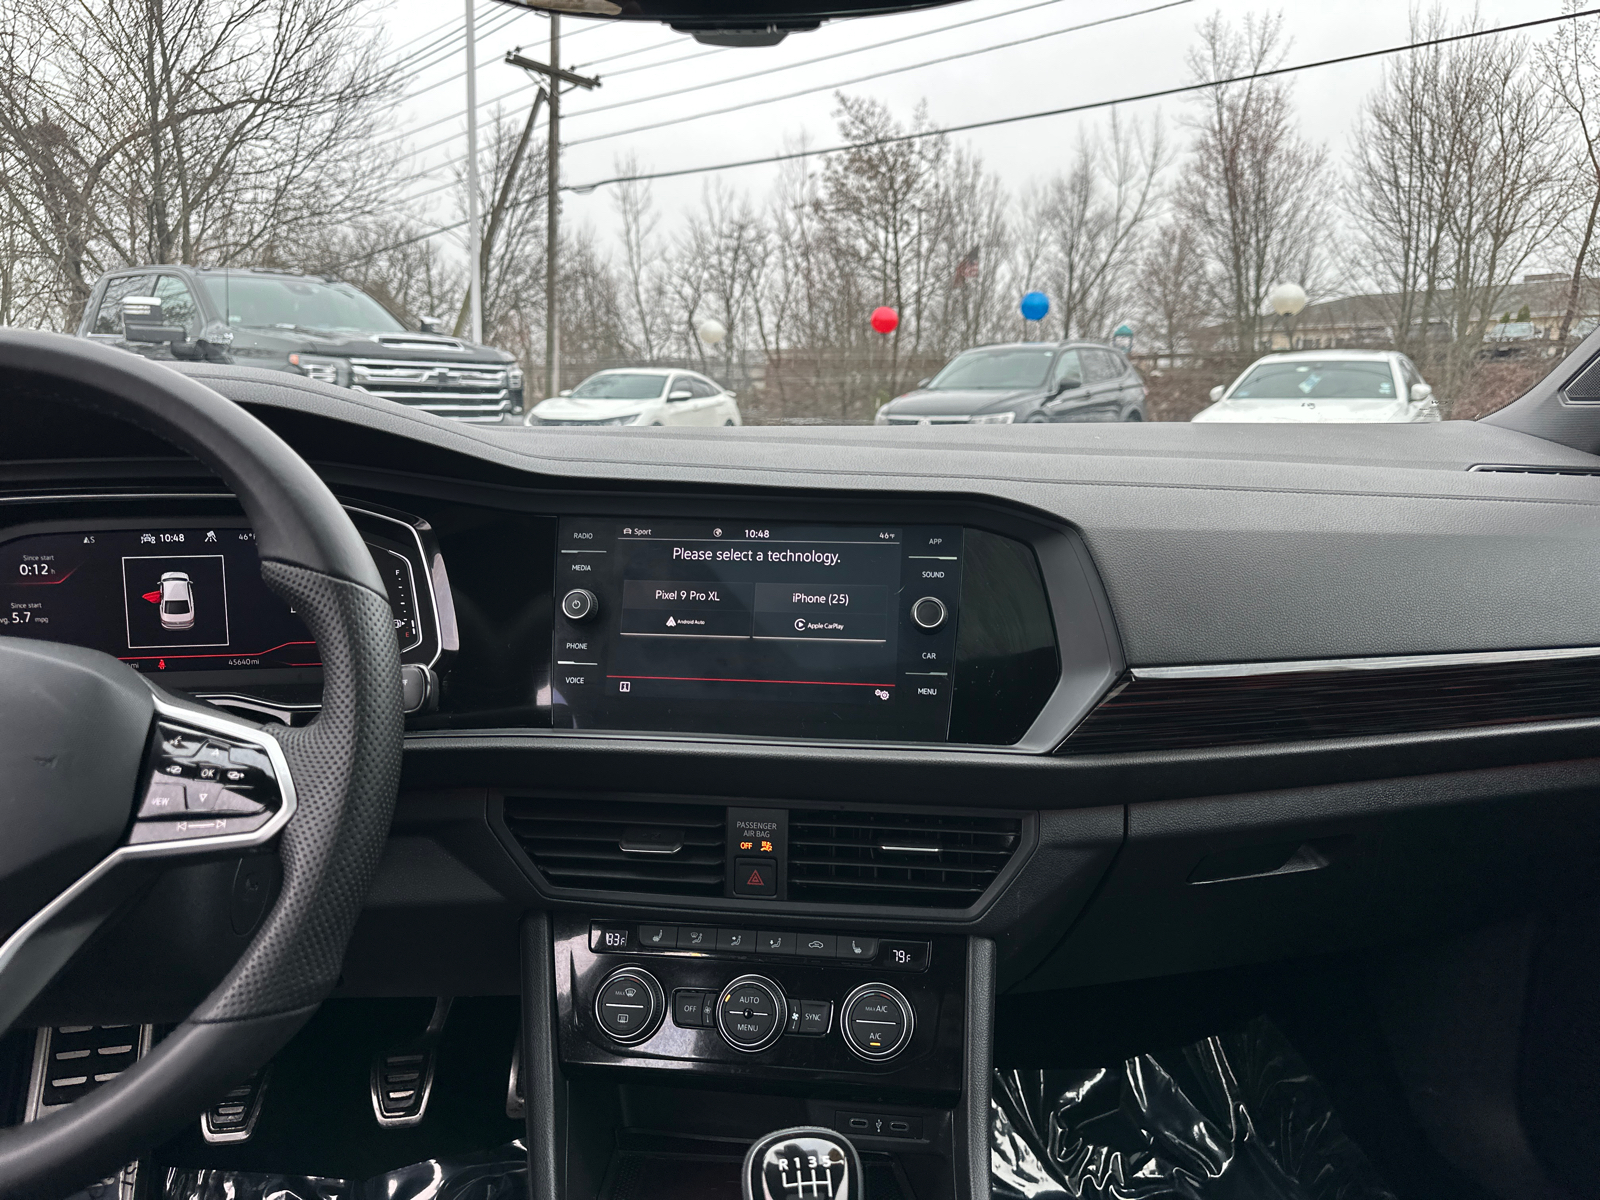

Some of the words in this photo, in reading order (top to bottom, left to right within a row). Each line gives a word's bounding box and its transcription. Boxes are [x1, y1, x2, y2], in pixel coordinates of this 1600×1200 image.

[573, 532, 593, 540] RADIO
[633, 528, 652, 536] Sport
[744, 529, 770, 538] 10:48
[159, 533, 185, 543] 10:48
[929, 538, 943, 546] APP
[672, 547, 713, 560] Please
[716, 548, 753, 561] select
[756, 552, 764, 562] a
[767, 549, 841, 566] technology.
[19, 563, 49, 576] 0:12
[571, 564, 592, 572] MEDIA
[921, 571, 945, 579] SOUND
[655, 589, 678, 601] Pixel
[680, 590, 687, 600] 9
[689, 591, 706, 602] Pro
[707, 591, 721, 602] XL
[792, 592, 826, 604] iPhone
[828, 593, 850, 606] (25)
[12, 611, 32, 624] 5.7
[677, 618, 695, 626] Android
[807, 622, 824, 630] Apple
[824, 622, 845, 631] CarPlay
[566, 642, 588, 650] PHONE
[921, 652, 937, 661] CAR
[565, 676, 585, 685] VOICE
[917, 687, 938, 696] MENU
[201, 768, 215, 778] OK
[151, 797, 170, 806] VIEW
[736, 821, 777, 830] PASSENGER
[756, 830, 770, 838] BAG
[740, 841, 753, 850] OFF
[739, 996, 760, 1004] AUTO
[684, 1004, 697, 1013] OFF
[876, 1004, 888, 1013] A/C
[805, 1013, 821, 1022] SYNC
[737, 1024, 759, 1032] MENU
[869, 1032, 882, 1041] A/C
[779, 1158, 789, 1171] R
[793, 1157, 801, 1169] 1
[807, 1156, 818, 1168] 3
[822, 1156, 832, 1168] 5
